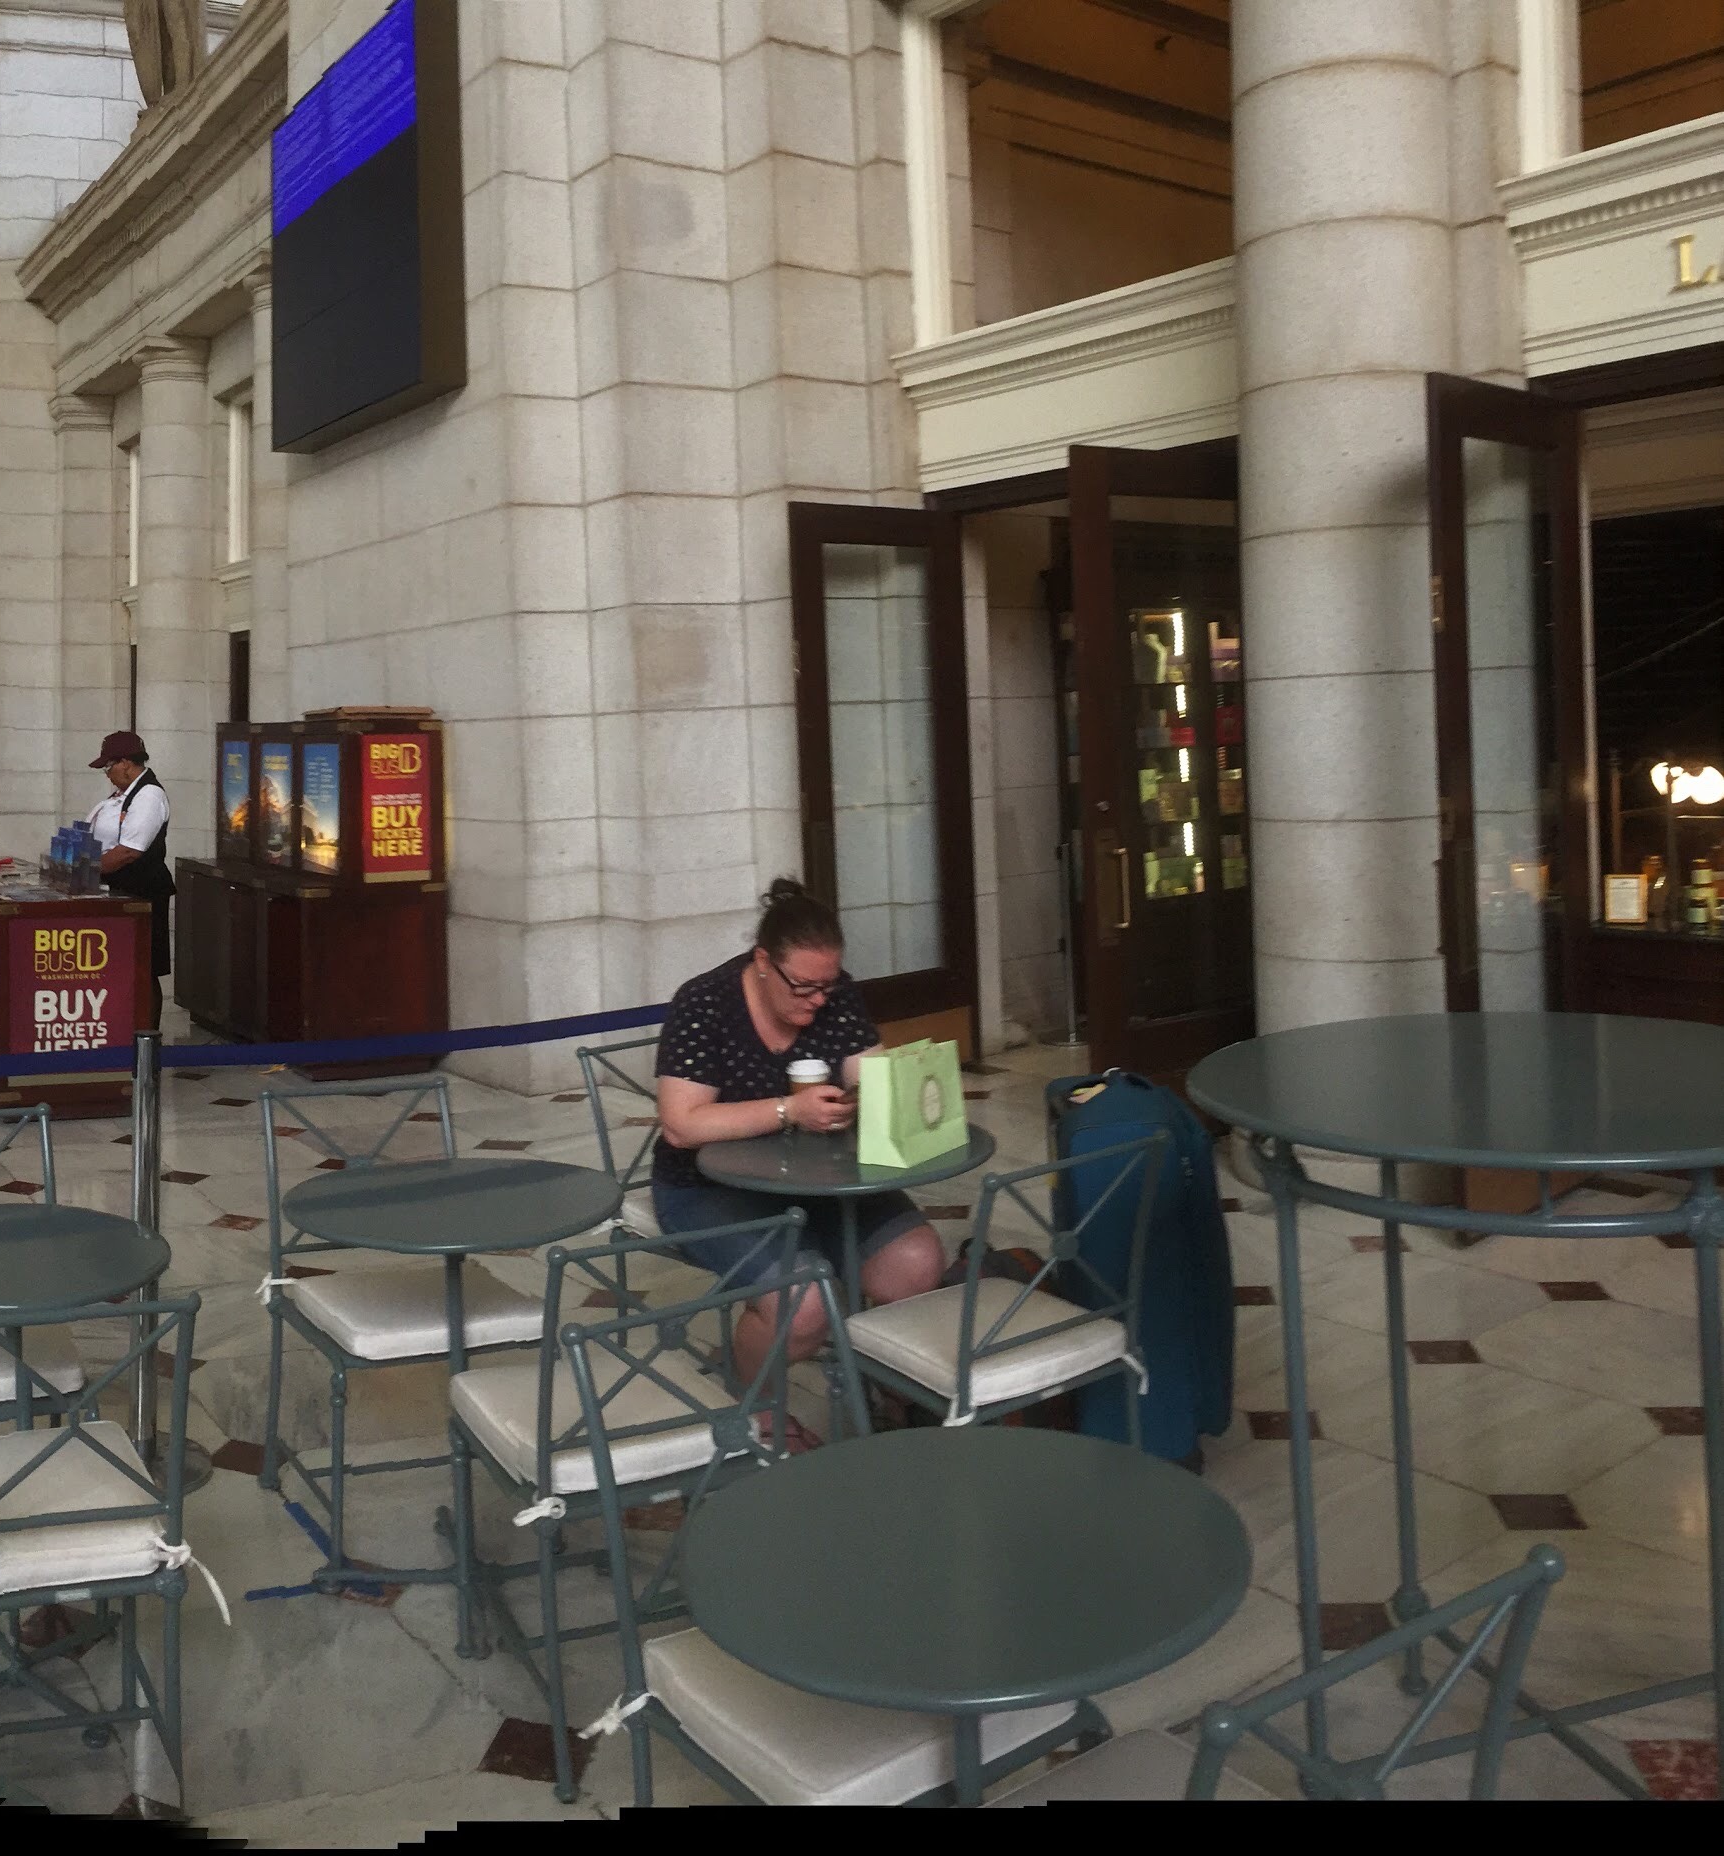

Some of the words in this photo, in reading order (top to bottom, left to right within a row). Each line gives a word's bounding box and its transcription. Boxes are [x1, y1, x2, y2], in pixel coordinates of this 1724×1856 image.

[370, 743, 400, 759] BIG
[371, 806, 423, 828] BUY
[372, 828, 423, 840] TICKETS
[371, 839, 424, 857] HERE
[34, 929, 76, 952] BIG
[34, 952, 76, 972] BUS
[34, 988, 108, 1022] BUY
[34, 1022, 108, 1039] TICKETS
